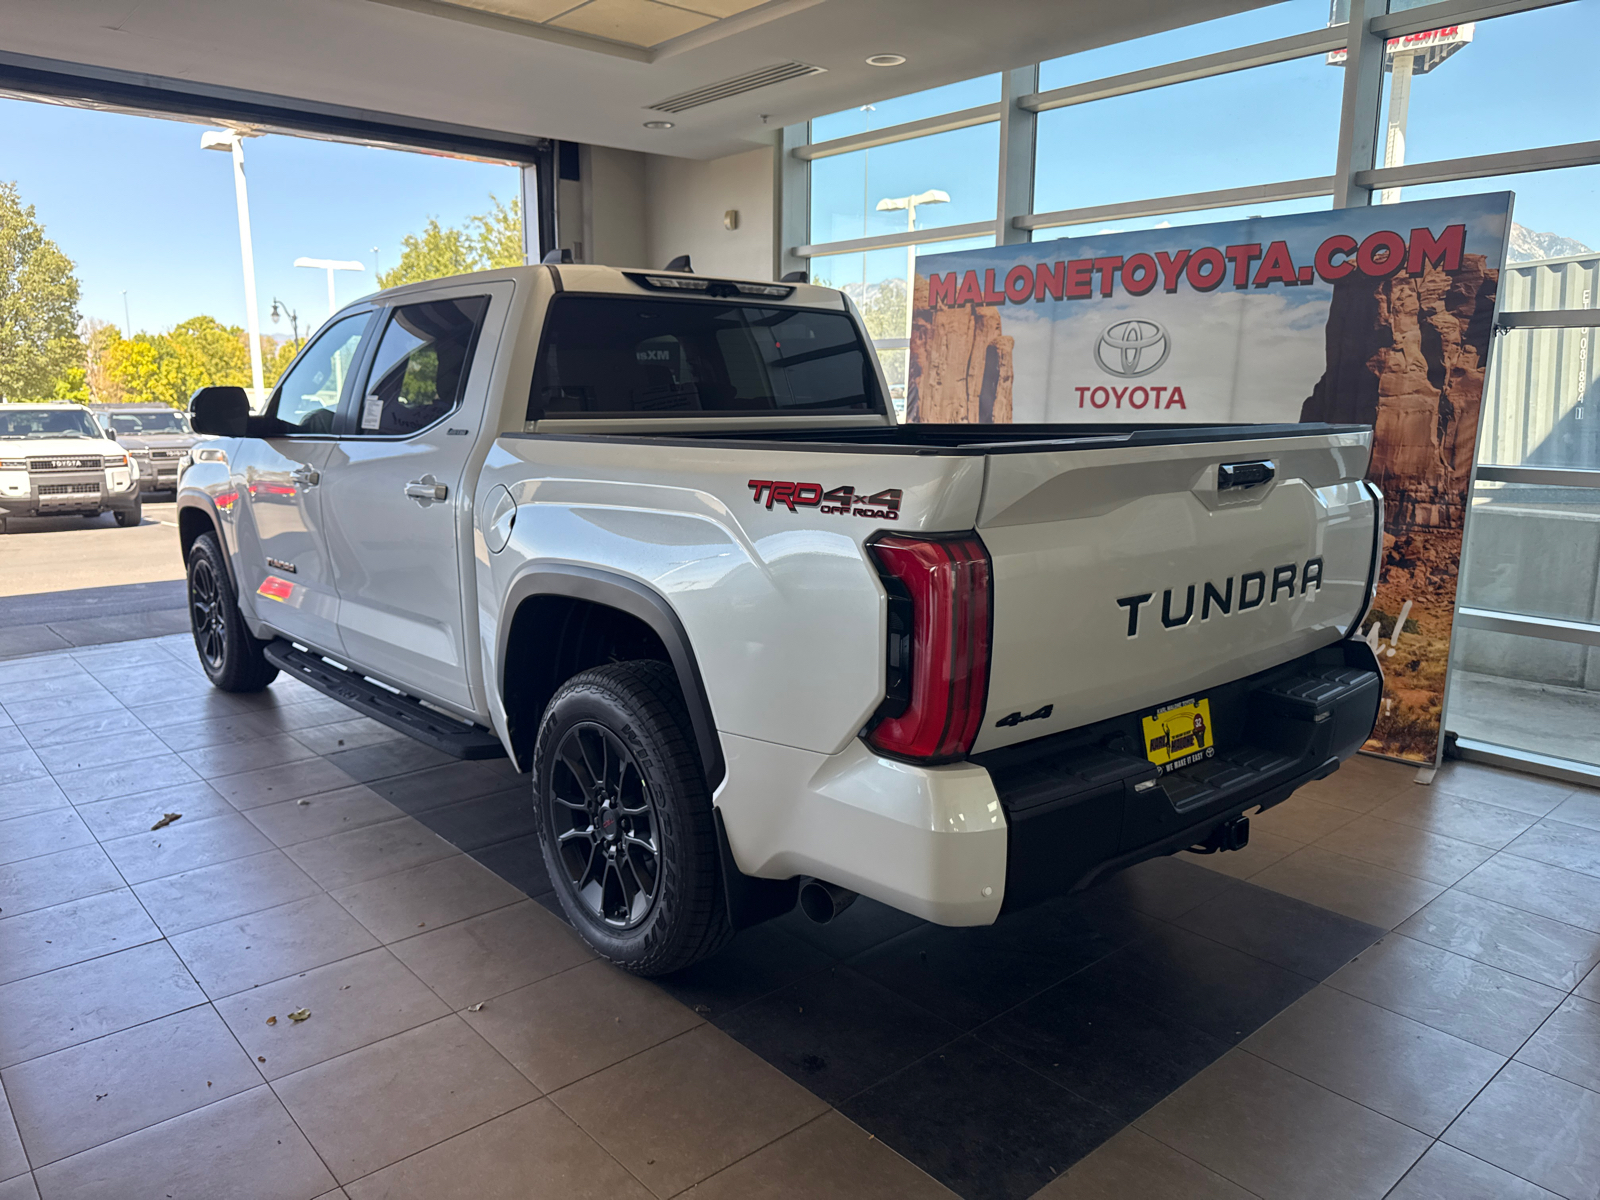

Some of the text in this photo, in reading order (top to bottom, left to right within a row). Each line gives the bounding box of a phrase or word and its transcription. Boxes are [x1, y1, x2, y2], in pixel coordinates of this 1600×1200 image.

[928, 224, 1466, 308] MALONETOYOTA.COM
[1075, 385, 1186, 410] TOYOTA
[51, 460, 82, 469] TOYOTA
[747, 479, 903, 514] TRD 4x4
[820, 505, 899, 520] OFF ROAD
[1116, 556, 1323, 638] TUNDRA
